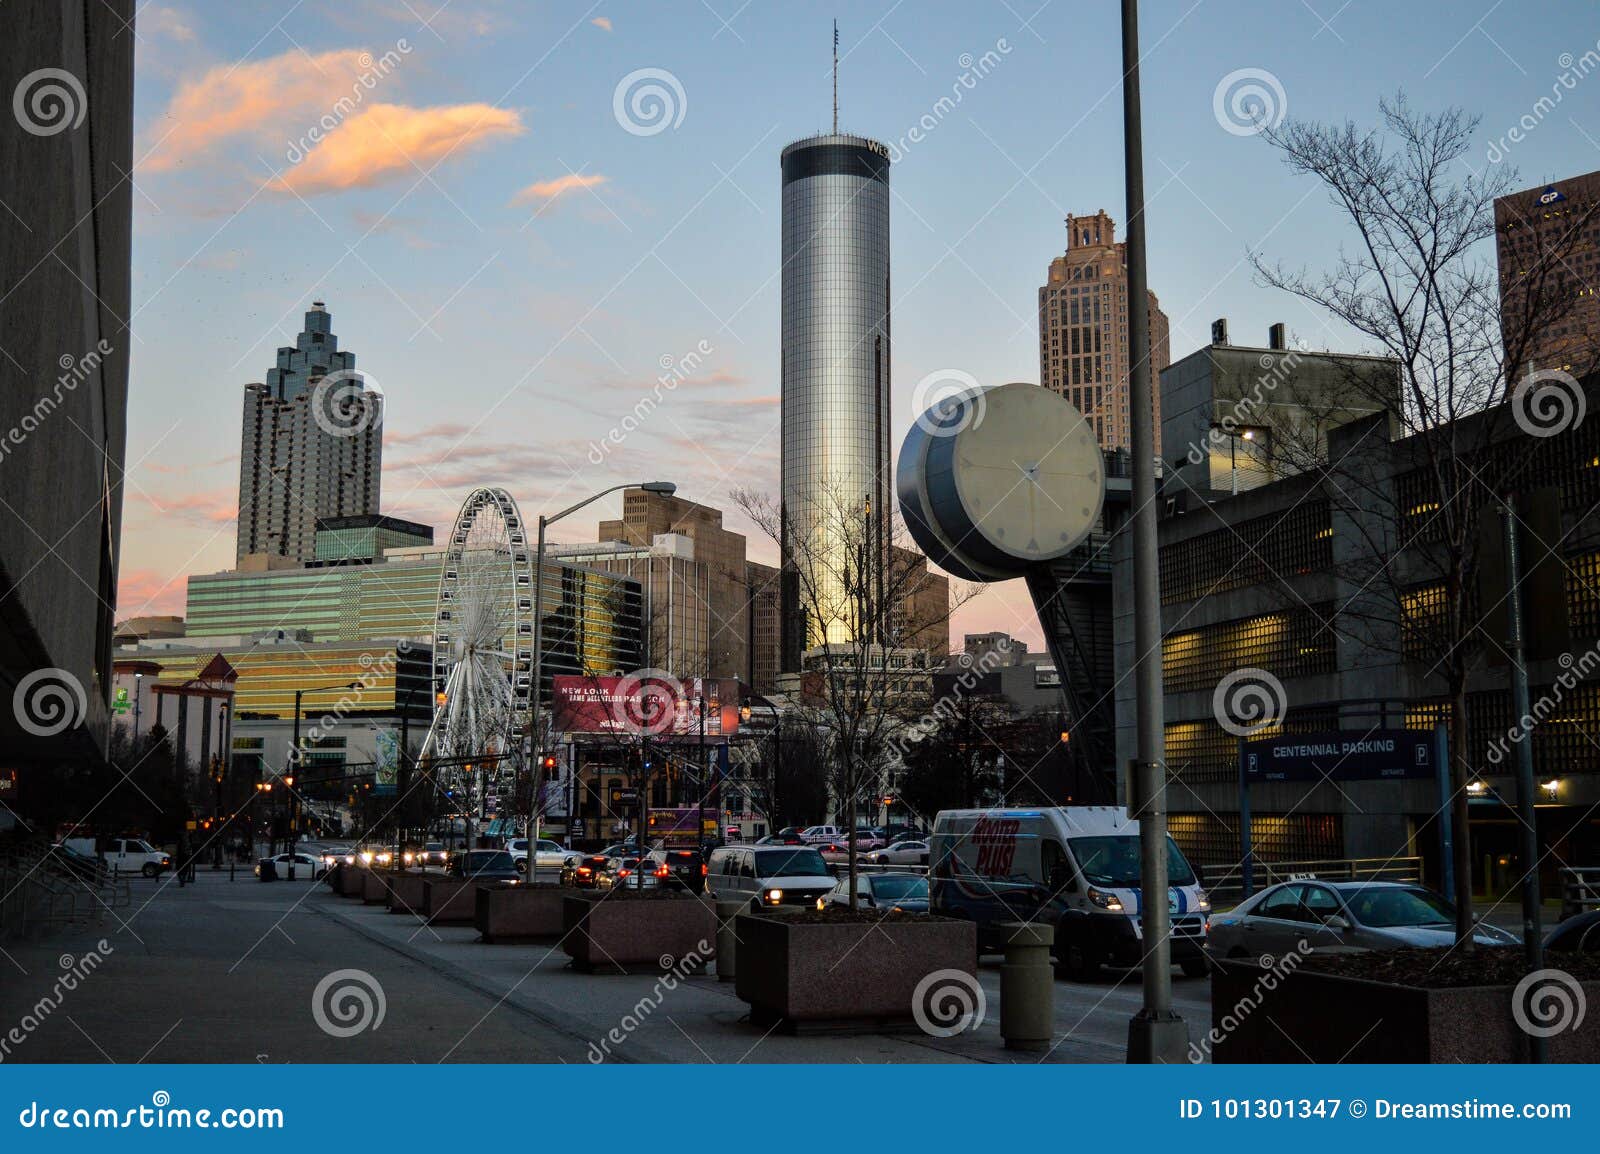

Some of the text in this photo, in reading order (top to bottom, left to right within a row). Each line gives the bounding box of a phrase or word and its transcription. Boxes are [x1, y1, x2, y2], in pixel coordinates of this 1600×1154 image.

[1540, 191, 1558, 204] GP
[561, 687, 581, 695] NEW
[1273, 739, 1395, 759] CENTENNIAL PARKING
